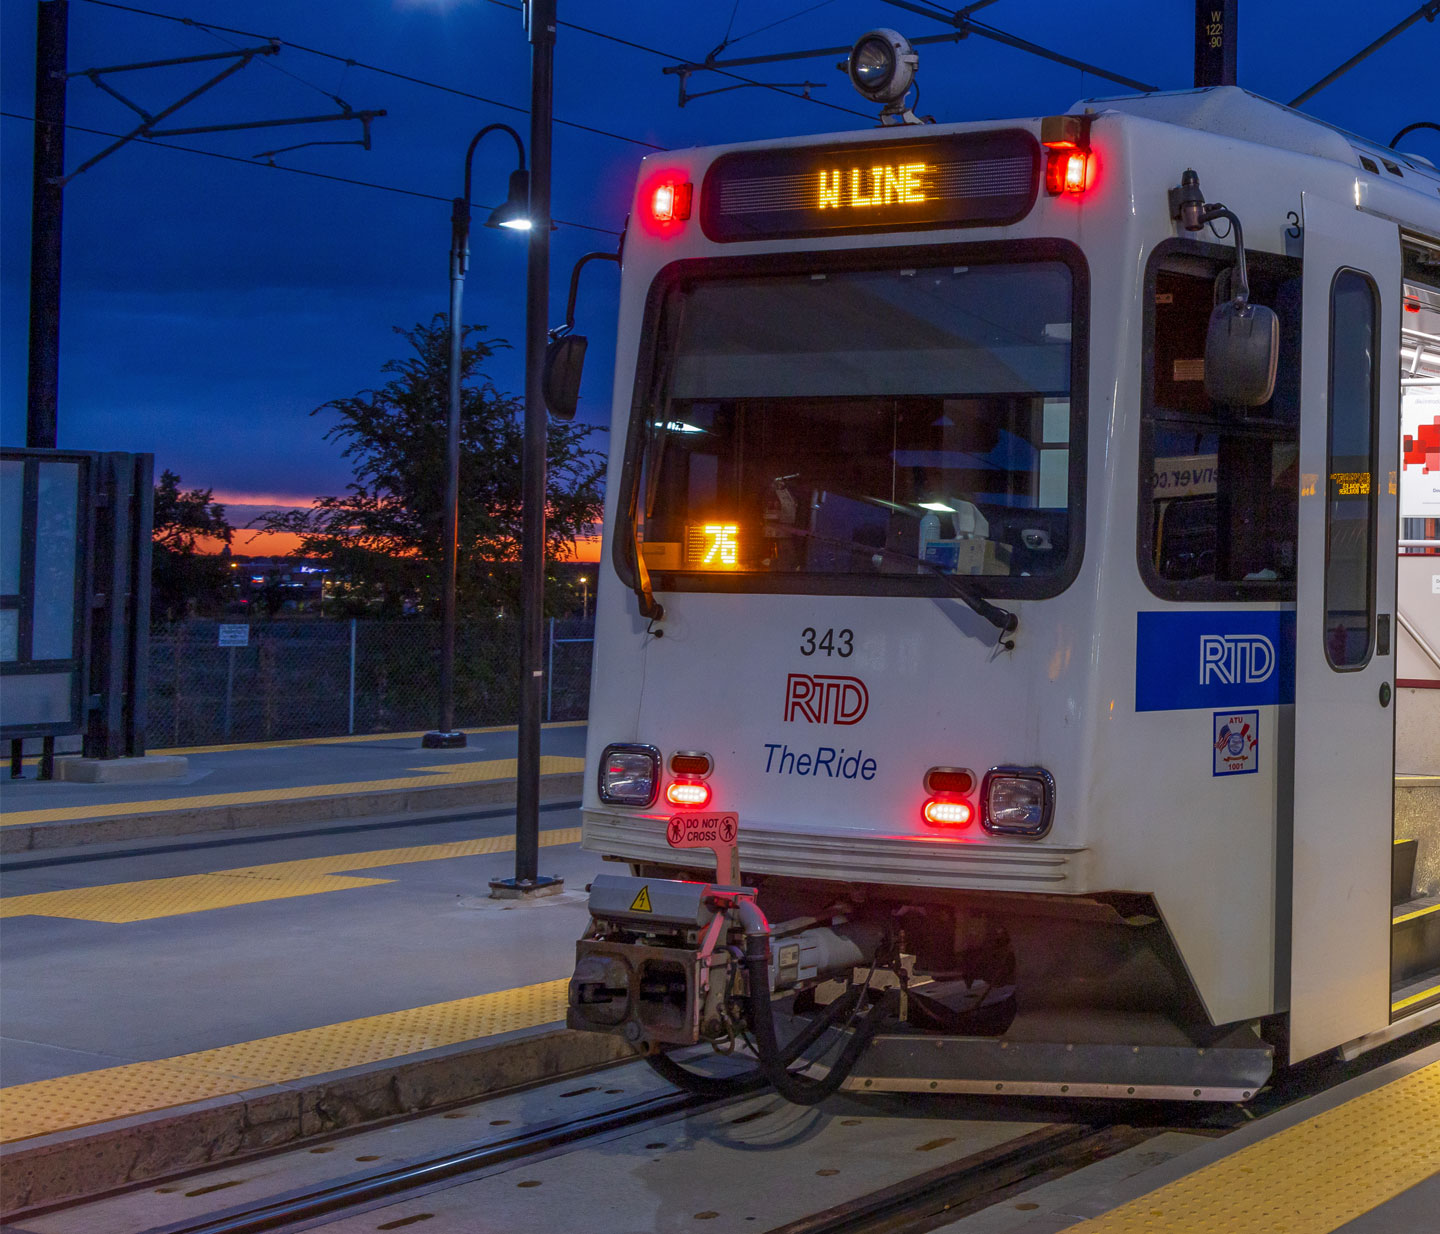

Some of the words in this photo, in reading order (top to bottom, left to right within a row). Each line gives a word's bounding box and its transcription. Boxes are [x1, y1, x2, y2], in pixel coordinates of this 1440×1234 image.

[1211, 11, 1221, 22] W
[818, 170, 839, 210] W
[852, 164, 925, 206] LINE
[703, 525, 738, 566] 76
[799, 627, 855, 658] 343
[1199, 634, 1276, 686] RTD
[783, 673, 870, 726] RTD
[1229, 716, 1243, 724] ATU
[763, 743, 878, 782] TheRide
[1228, 763, 1244, 771] 1001
[687, 819, 699, 828] DO
[702, 818, 719, 828] NOT
[688, 831, 716, 841] CROSS
